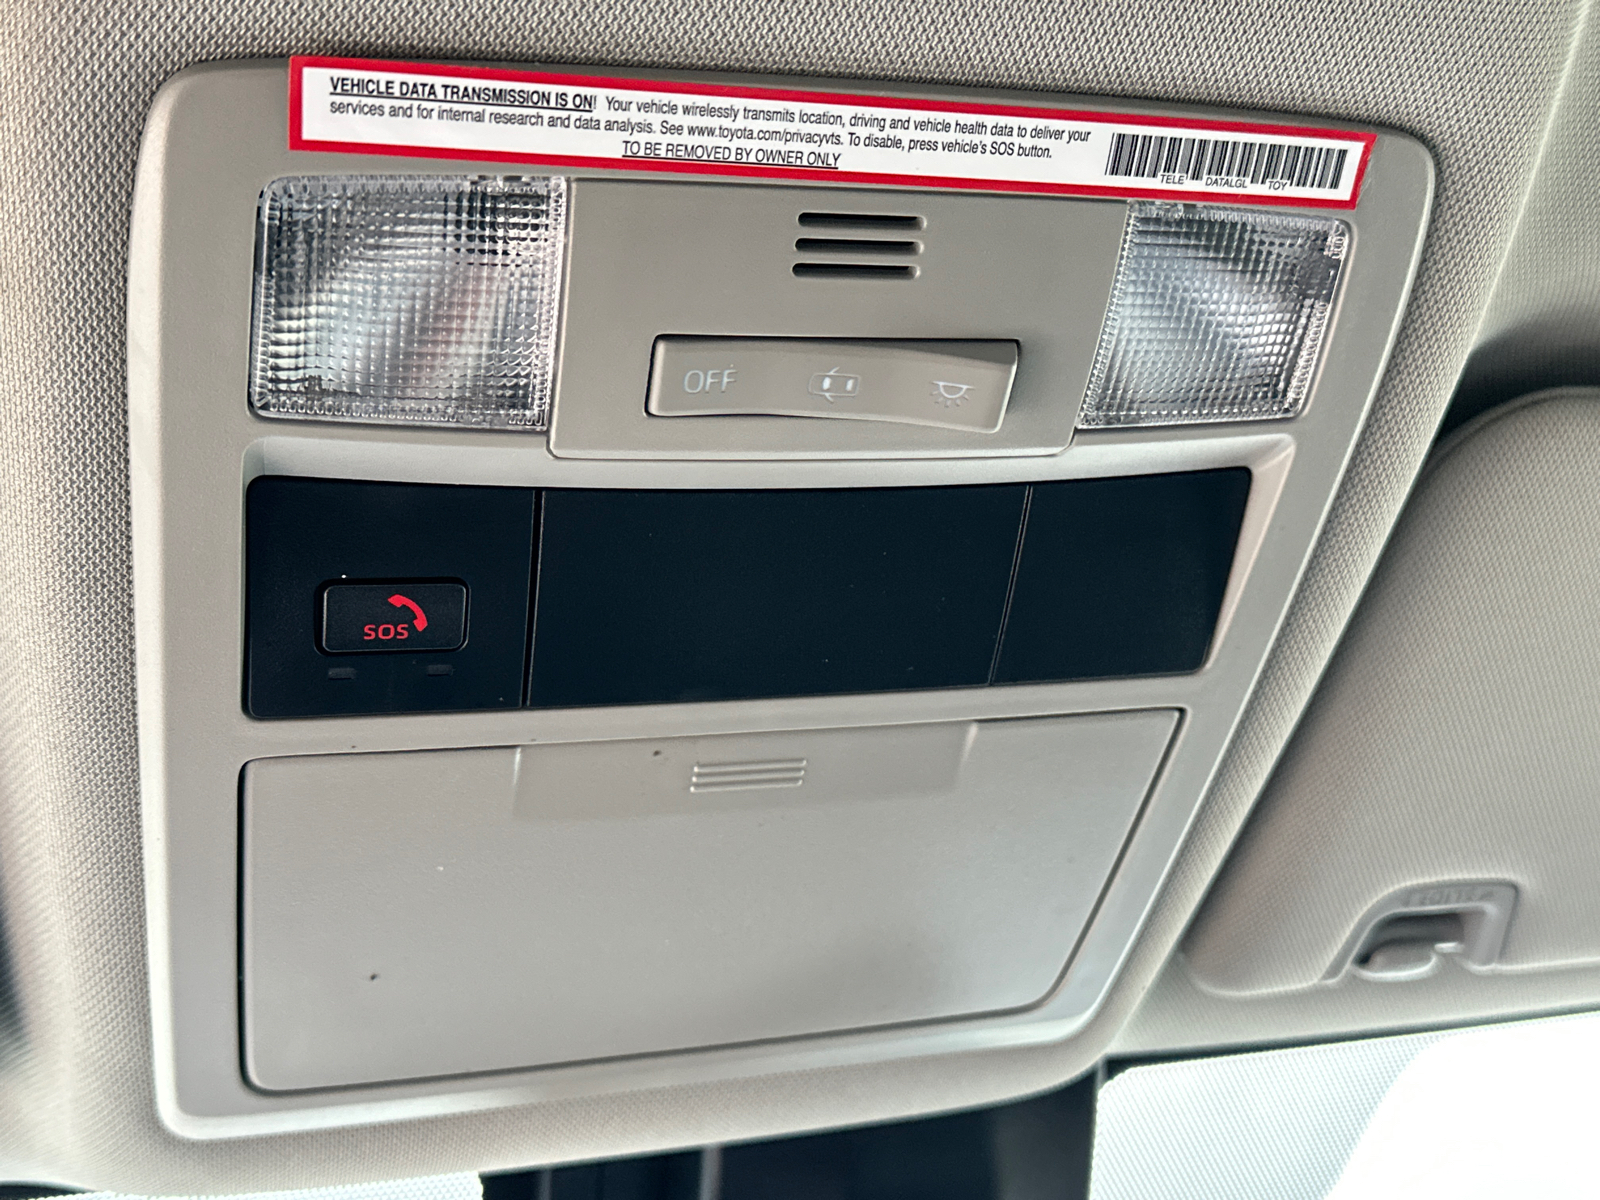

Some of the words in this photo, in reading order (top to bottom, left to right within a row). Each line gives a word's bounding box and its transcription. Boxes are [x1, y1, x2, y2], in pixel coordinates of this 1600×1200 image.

[330, 76, 395, 95] VEHICLE
[400, 81, 437, 99] DATA
[441, 84, 551, 107] TRANSMISSION
[555, 92, 568, 107] IS
[605, 96, 633, 113] Your
[636, 98, 678, 115] vehicle
[682, 101, 740, 122] wirelessly
[743, 104, 796, 123] transmits
[798, 108, 846, 127] location,
[849, 113, 886, 131] driving
[889, 115, 910, 130] and
[914, 117, 951, 133] vehicle
[954, 120, 988, 135] health
[990, 122, 1014, 137] data
[1017, 125, 1027, 138] to
[1029, 125, 1065, 140] deliver
[1067, 129, 1091, 144] your
[330, 99, 385, 116] services
[388, 102, 413, 118] and
[416, 104, 434, 119] for
[437, 105, 485, 123] internal
[489, 109, 544, 127] research
[547, 114, 570, 129] and
[573, 116, 601, 131] data
[604, 118, 656, 136] analysis.
[660, 120, 684, 135] See
[687, 123, 844, 148] www.toyota.com/privacyvts.
[848, 132, 861, 146] To
[863, 134, 905, 151] disable,
[907, 139, 938, 153] press
[941, 138, 987, 154] vehicle's
[989, 141, 1015, 156] SOS
[1017, 144, 1052, 158] button.
[622, 140, 641, 156] TO
[644, 142, 662, 156] BE
[665, 143, 731, 161] REMOVED
[735, 147, 753, 162] BY
[755, 149, 803, 165] OWNER
[806, 151, 842, 167] ONLY
[1160, 174, 1185, 186] TELE
[1205, 177, 1248, 189] DATALGL
[1268, 180, 1288, 191] TOY
[683, 369, 738, 394] OFF
[363, 623, 409, 640] SOS
